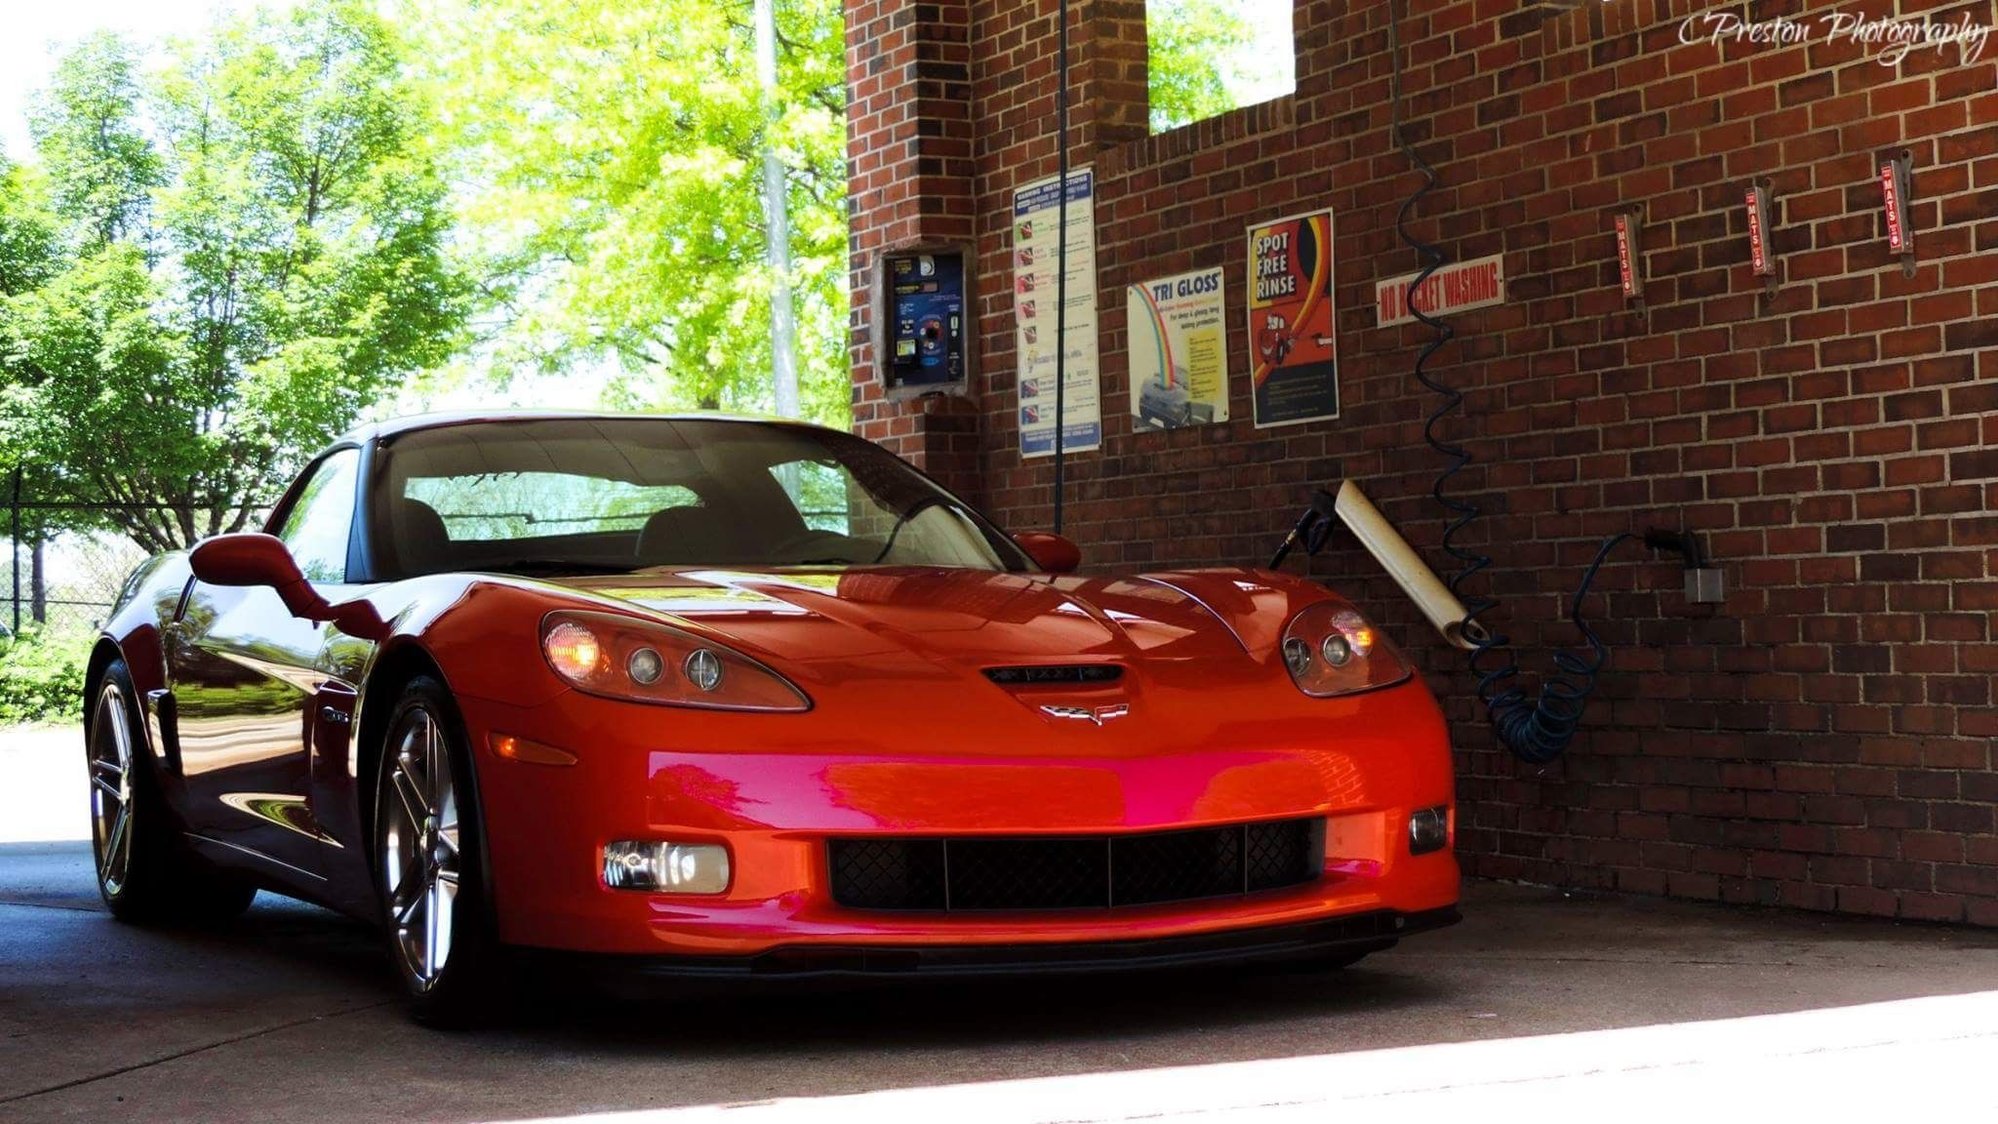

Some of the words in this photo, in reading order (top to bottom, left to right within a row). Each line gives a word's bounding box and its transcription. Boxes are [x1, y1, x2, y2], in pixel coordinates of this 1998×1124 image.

[1884, 180, 1896, 222] MATS
[1748, 205, 1760, 245] MATS
[1257, 232, 1289, 255] SPOT
[1617, 231, 1628, 269] MATS
[1257, 254, 1288, 277] FREE
[1153, 282, 1173, 302] TRI
[1177, 273, 1219, 297] GLOSS
[1257, 275, 1296, 299] RINSE
[1380, 285, 1396, 321] NO
[1398, 274, 1441, 318] BCKET
[1443, 262, 1499, 308] WASHING
